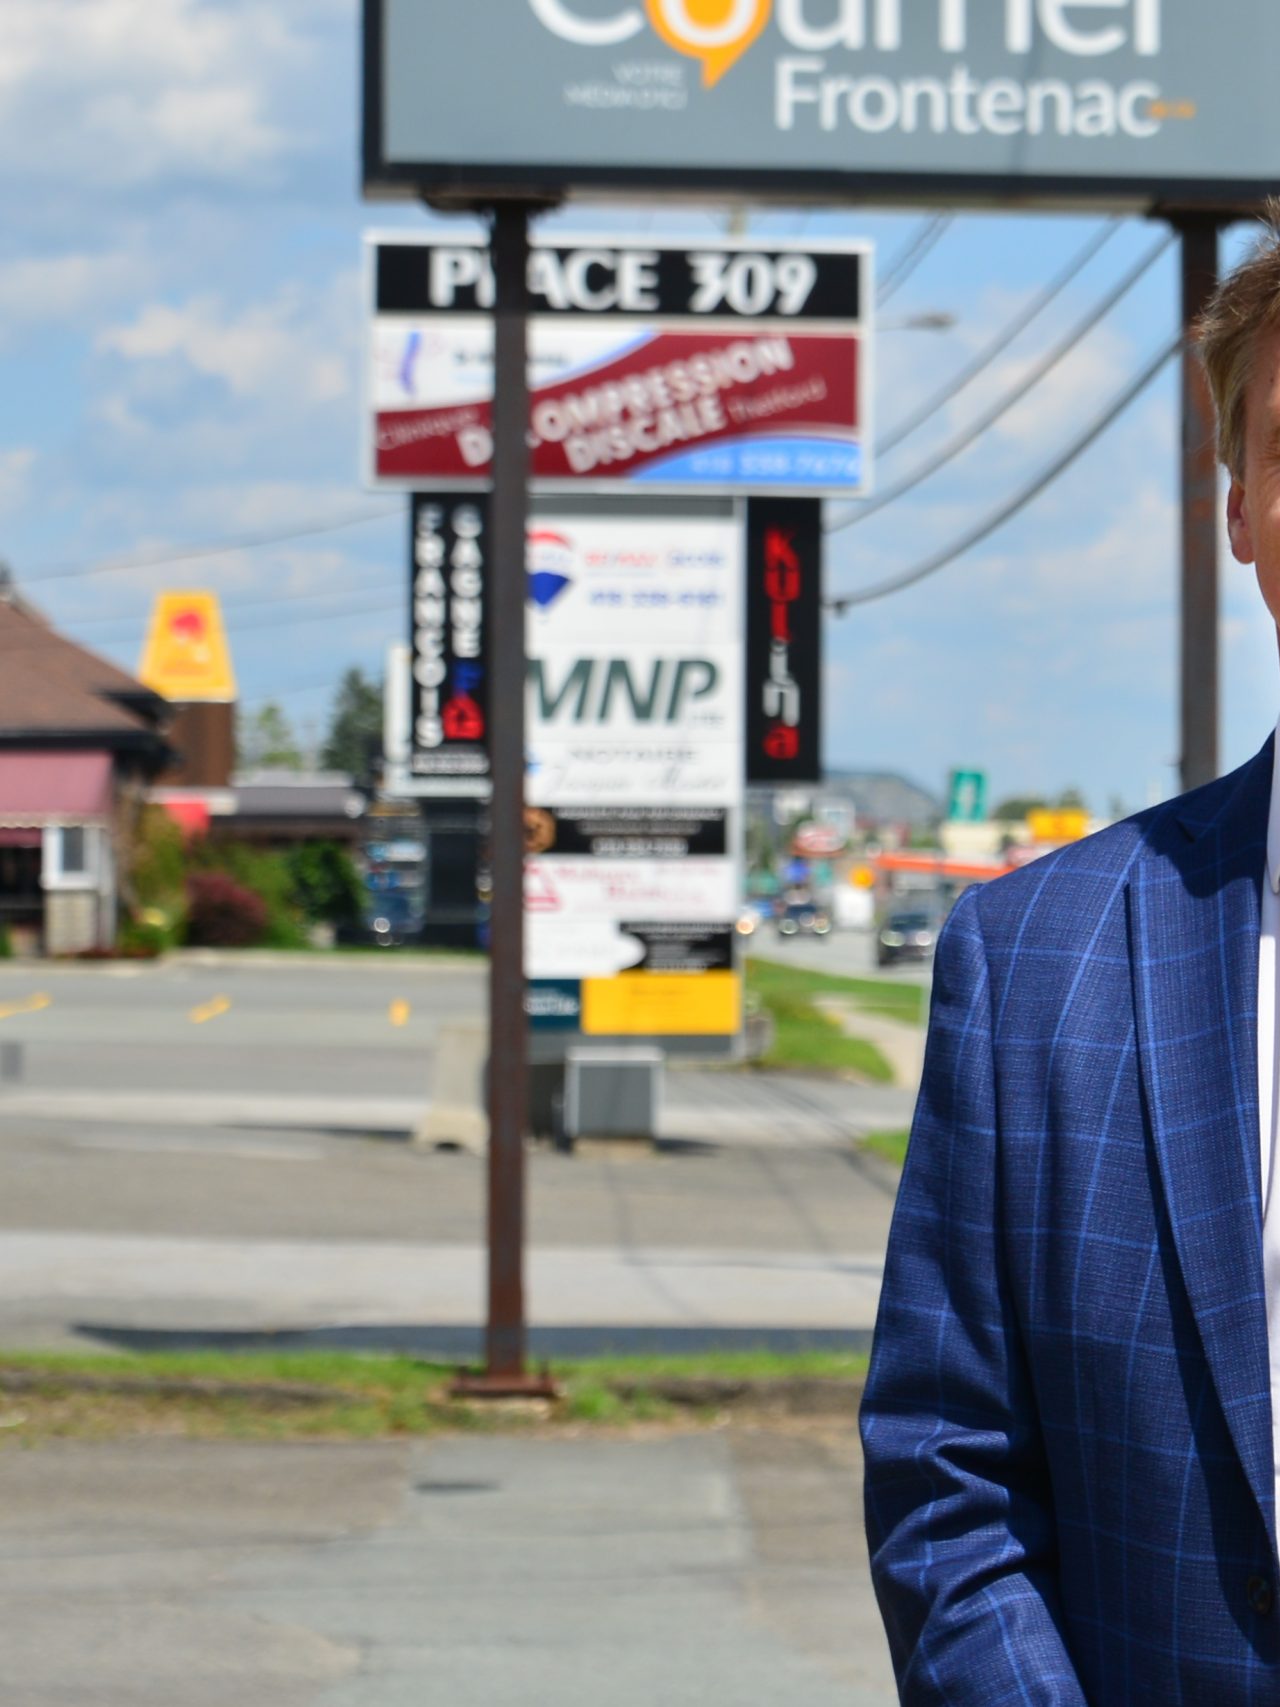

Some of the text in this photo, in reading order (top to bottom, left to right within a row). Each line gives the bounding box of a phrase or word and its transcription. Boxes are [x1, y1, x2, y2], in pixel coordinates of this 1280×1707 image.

[774, 56, 1161, 138] Frontenac
[688, 252, 817, 315] 309
[456, 335, 796, 468] DOMPRESSION
[563, 394, 726, 473] DISCALE
[527, 658, 721, 723] MNP
